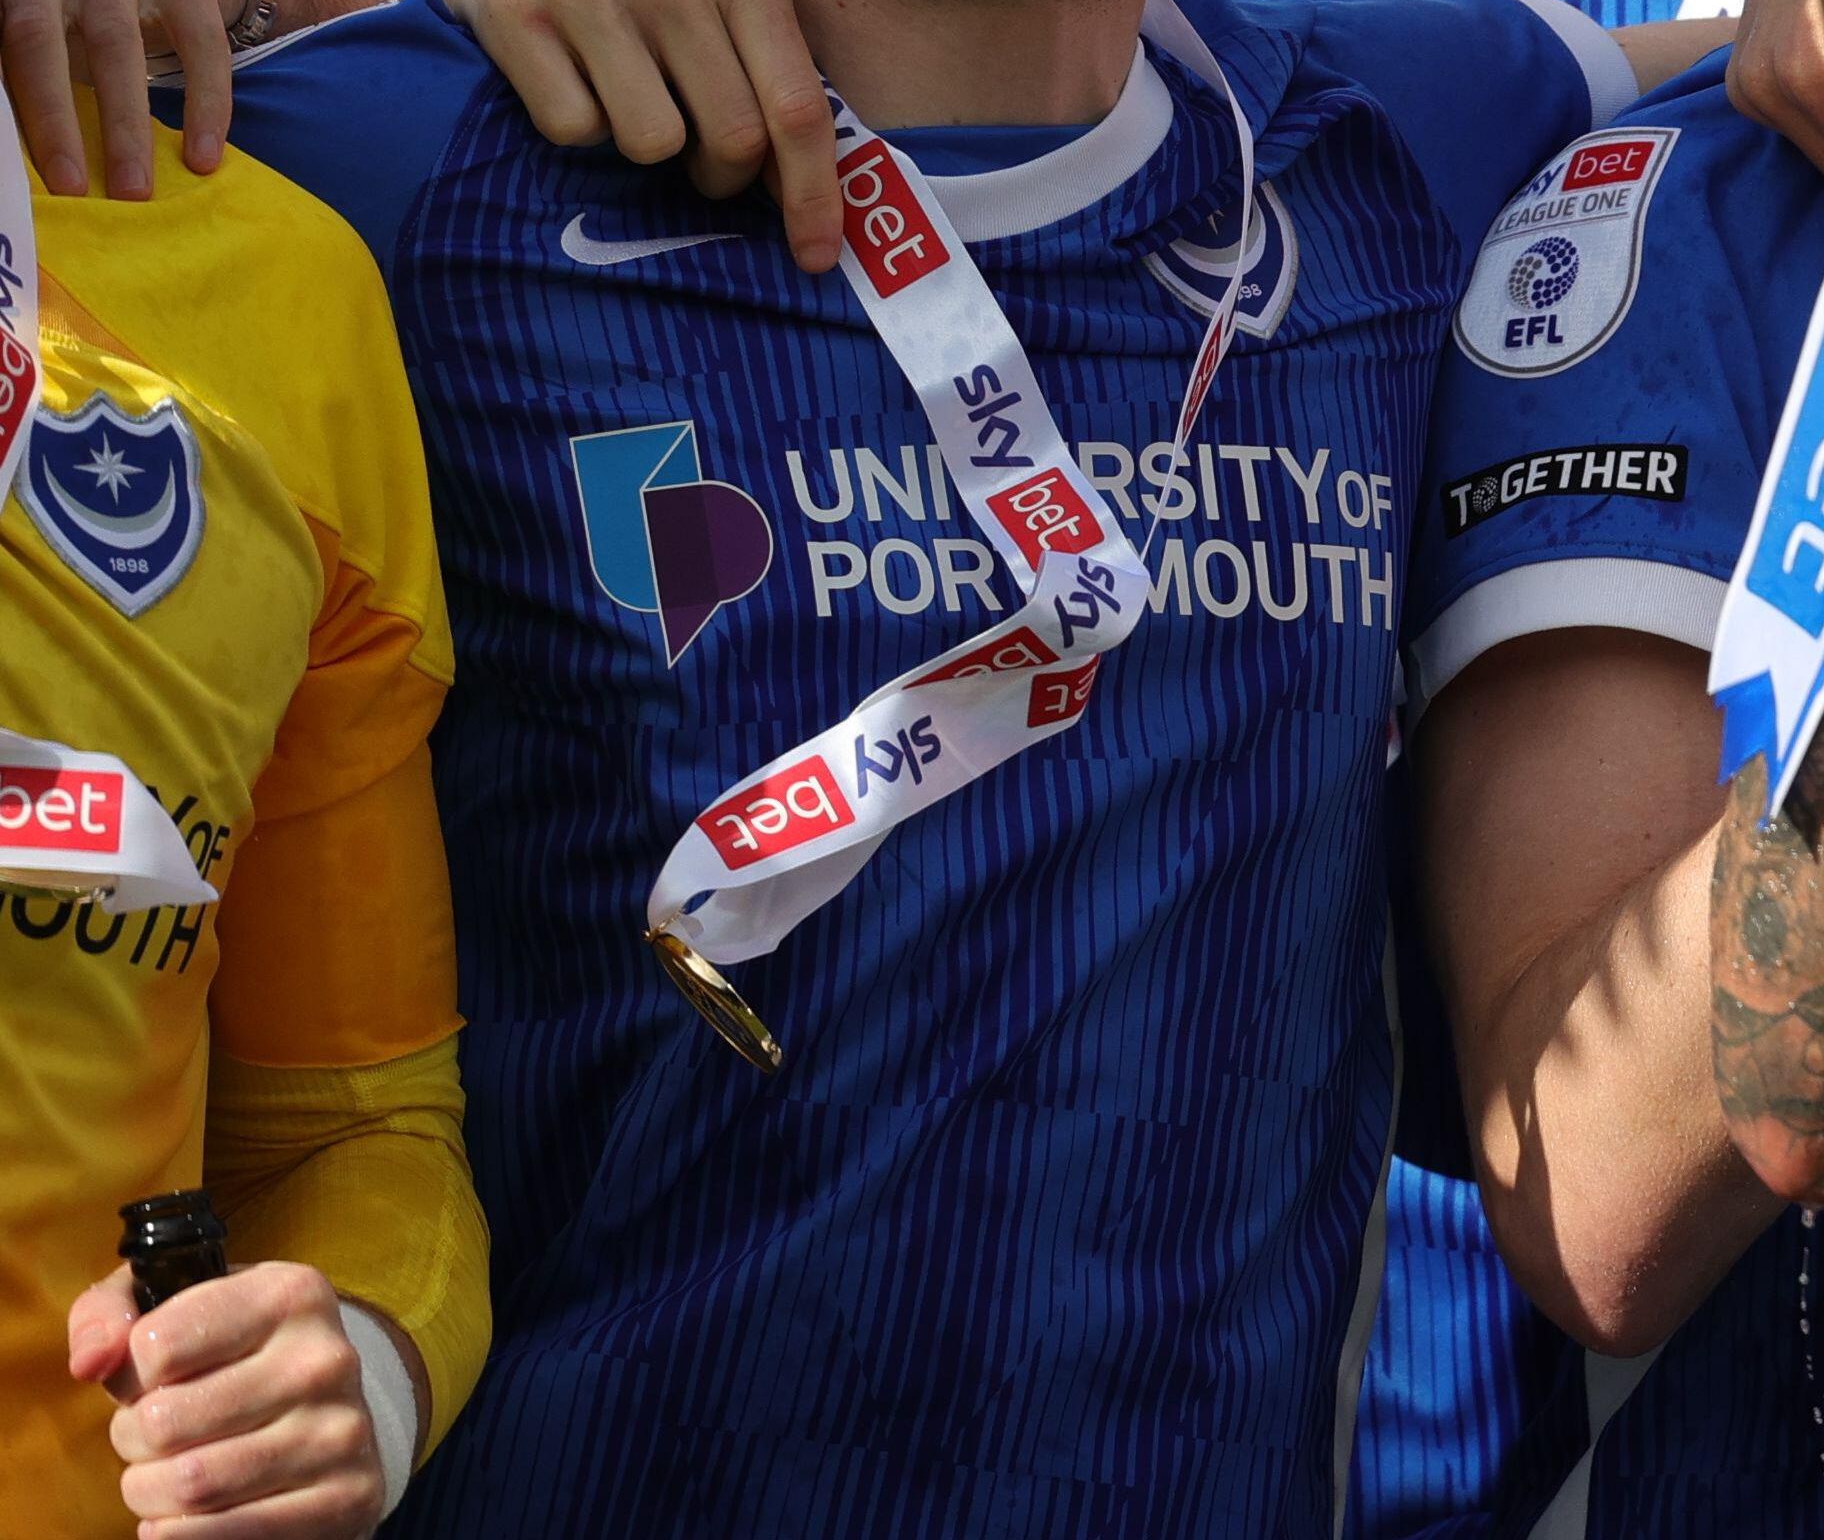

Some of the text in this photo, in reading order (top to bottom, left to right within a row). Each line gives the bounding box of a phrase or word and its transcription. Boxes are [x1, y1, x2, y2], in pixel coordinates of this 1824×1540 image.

[1573, 147, 1642, 180] bet
[837, 154, 926, 277] bet
[1494, 187, 1632, 234] LEAGUE ONE
[1504, 314, 1564, 349] EFL
[784, 442, 1393, 531] UNIRSITY OF
[953, 363, 1081, 551] sky bet
[108, 556, 150, 574] 1898
[807, 538, 1394, 630] PORMOUTH
[1053, 555, 1121, 650] sky
[715, 714, 942, 851] sky bet
